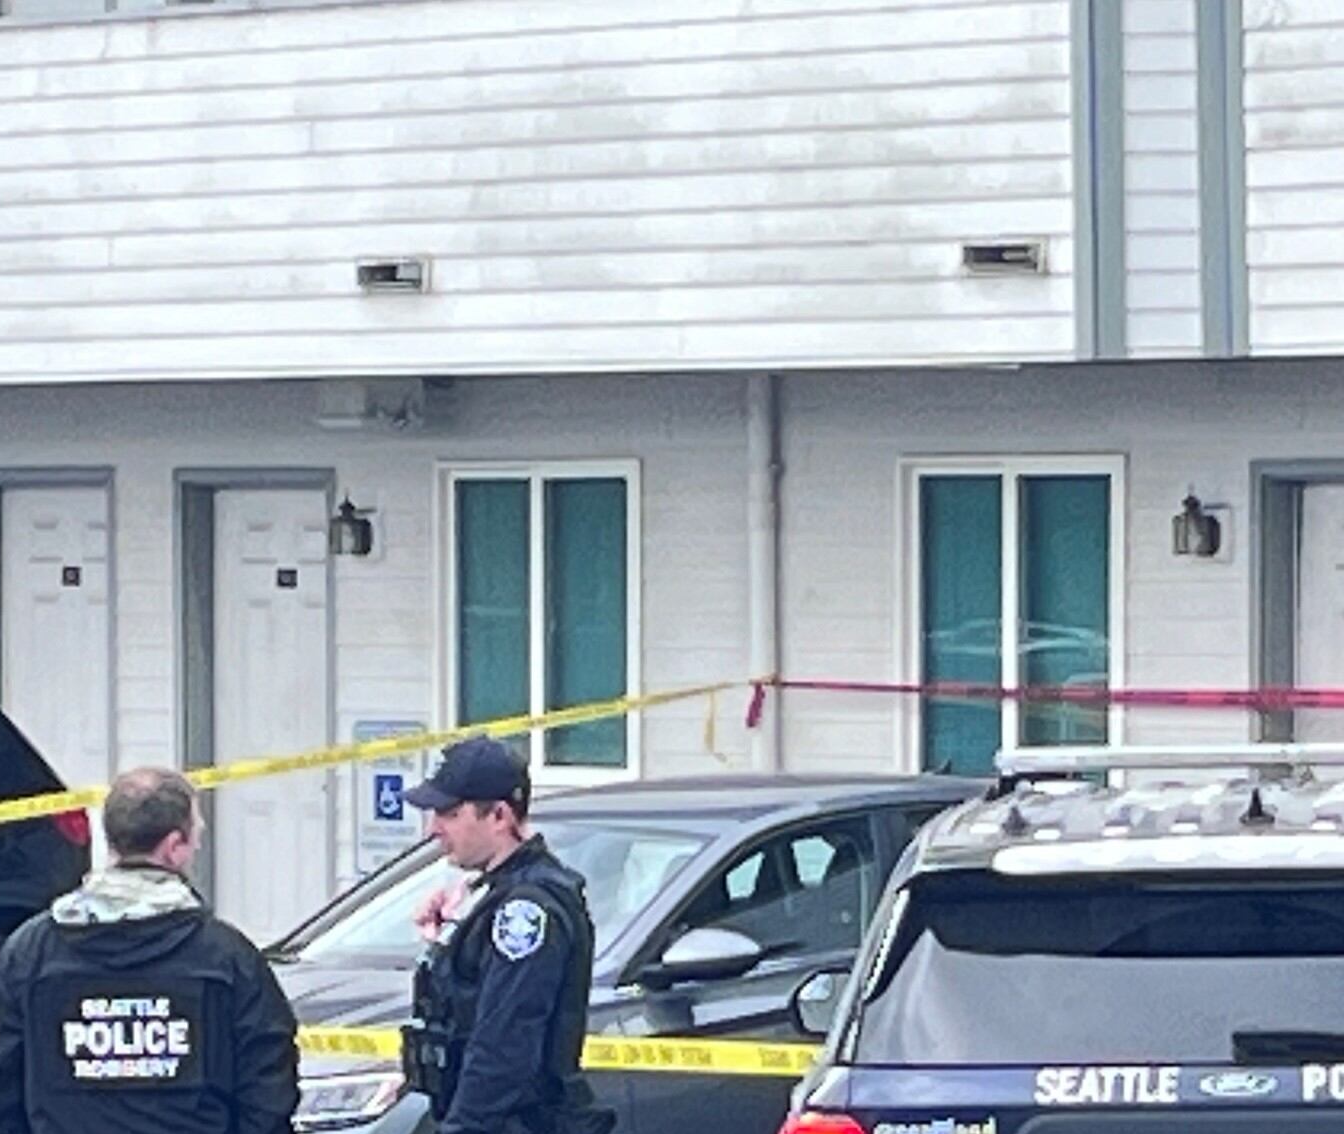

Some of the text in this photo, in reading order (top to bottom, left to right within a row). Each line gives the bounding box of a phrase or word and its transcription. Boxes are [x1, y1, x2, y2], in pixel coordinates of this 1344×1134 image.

[81, 998, 170, 1018] SEATTLE
[63, 1019, 190, 1057] POLICE
[74, 1058, 179, 1078] ROBBERY
[1033, 1067, 1181, 1104] SEATTLE
